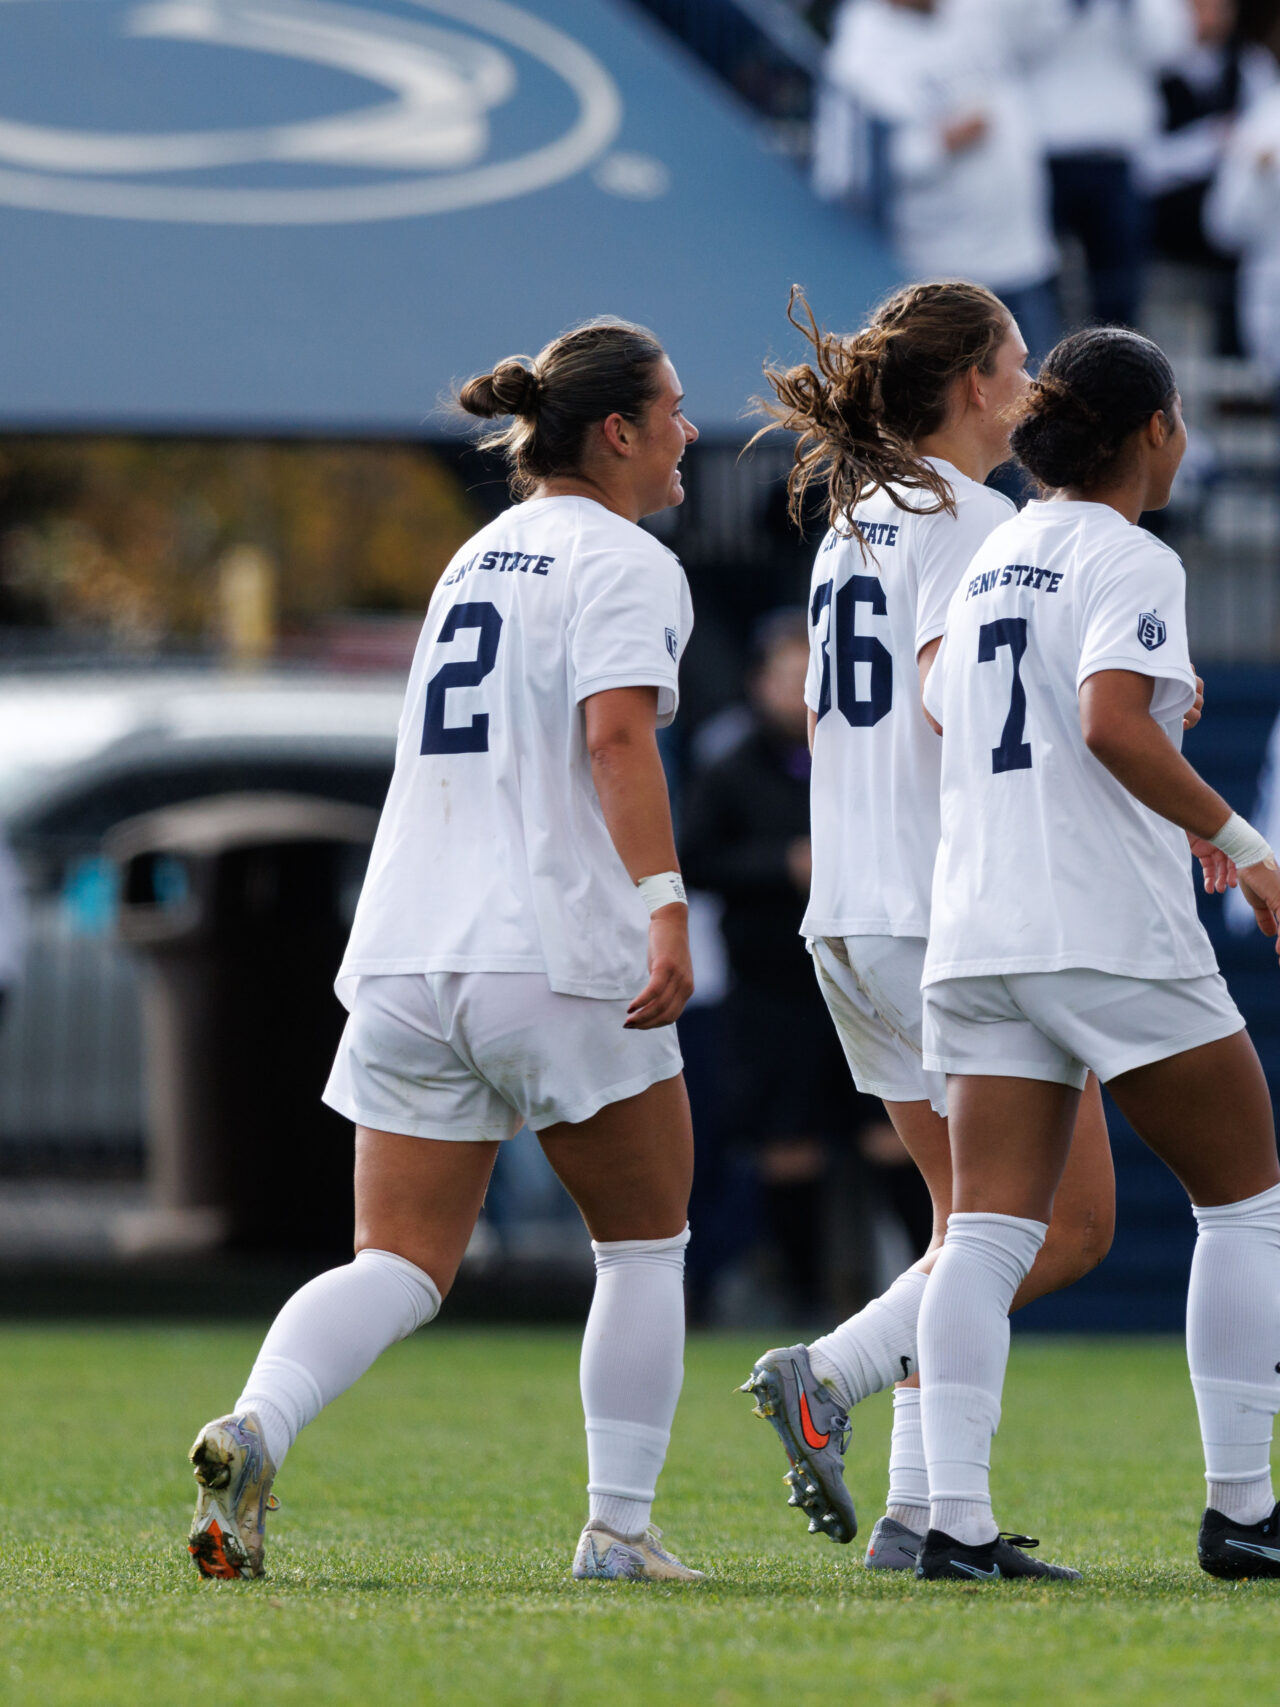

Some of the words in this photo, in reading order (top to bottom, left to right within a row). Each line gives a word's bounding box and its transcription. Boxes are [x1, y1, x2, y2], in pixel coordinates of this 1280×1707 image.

[478, 551, 556, 576] STATE
[965, 567, 1001, 602] PENN
[999, 565, 1064, 593] STATE
[419, 601, 504, 756] 2
[977, 617, 1033, 775] 7
